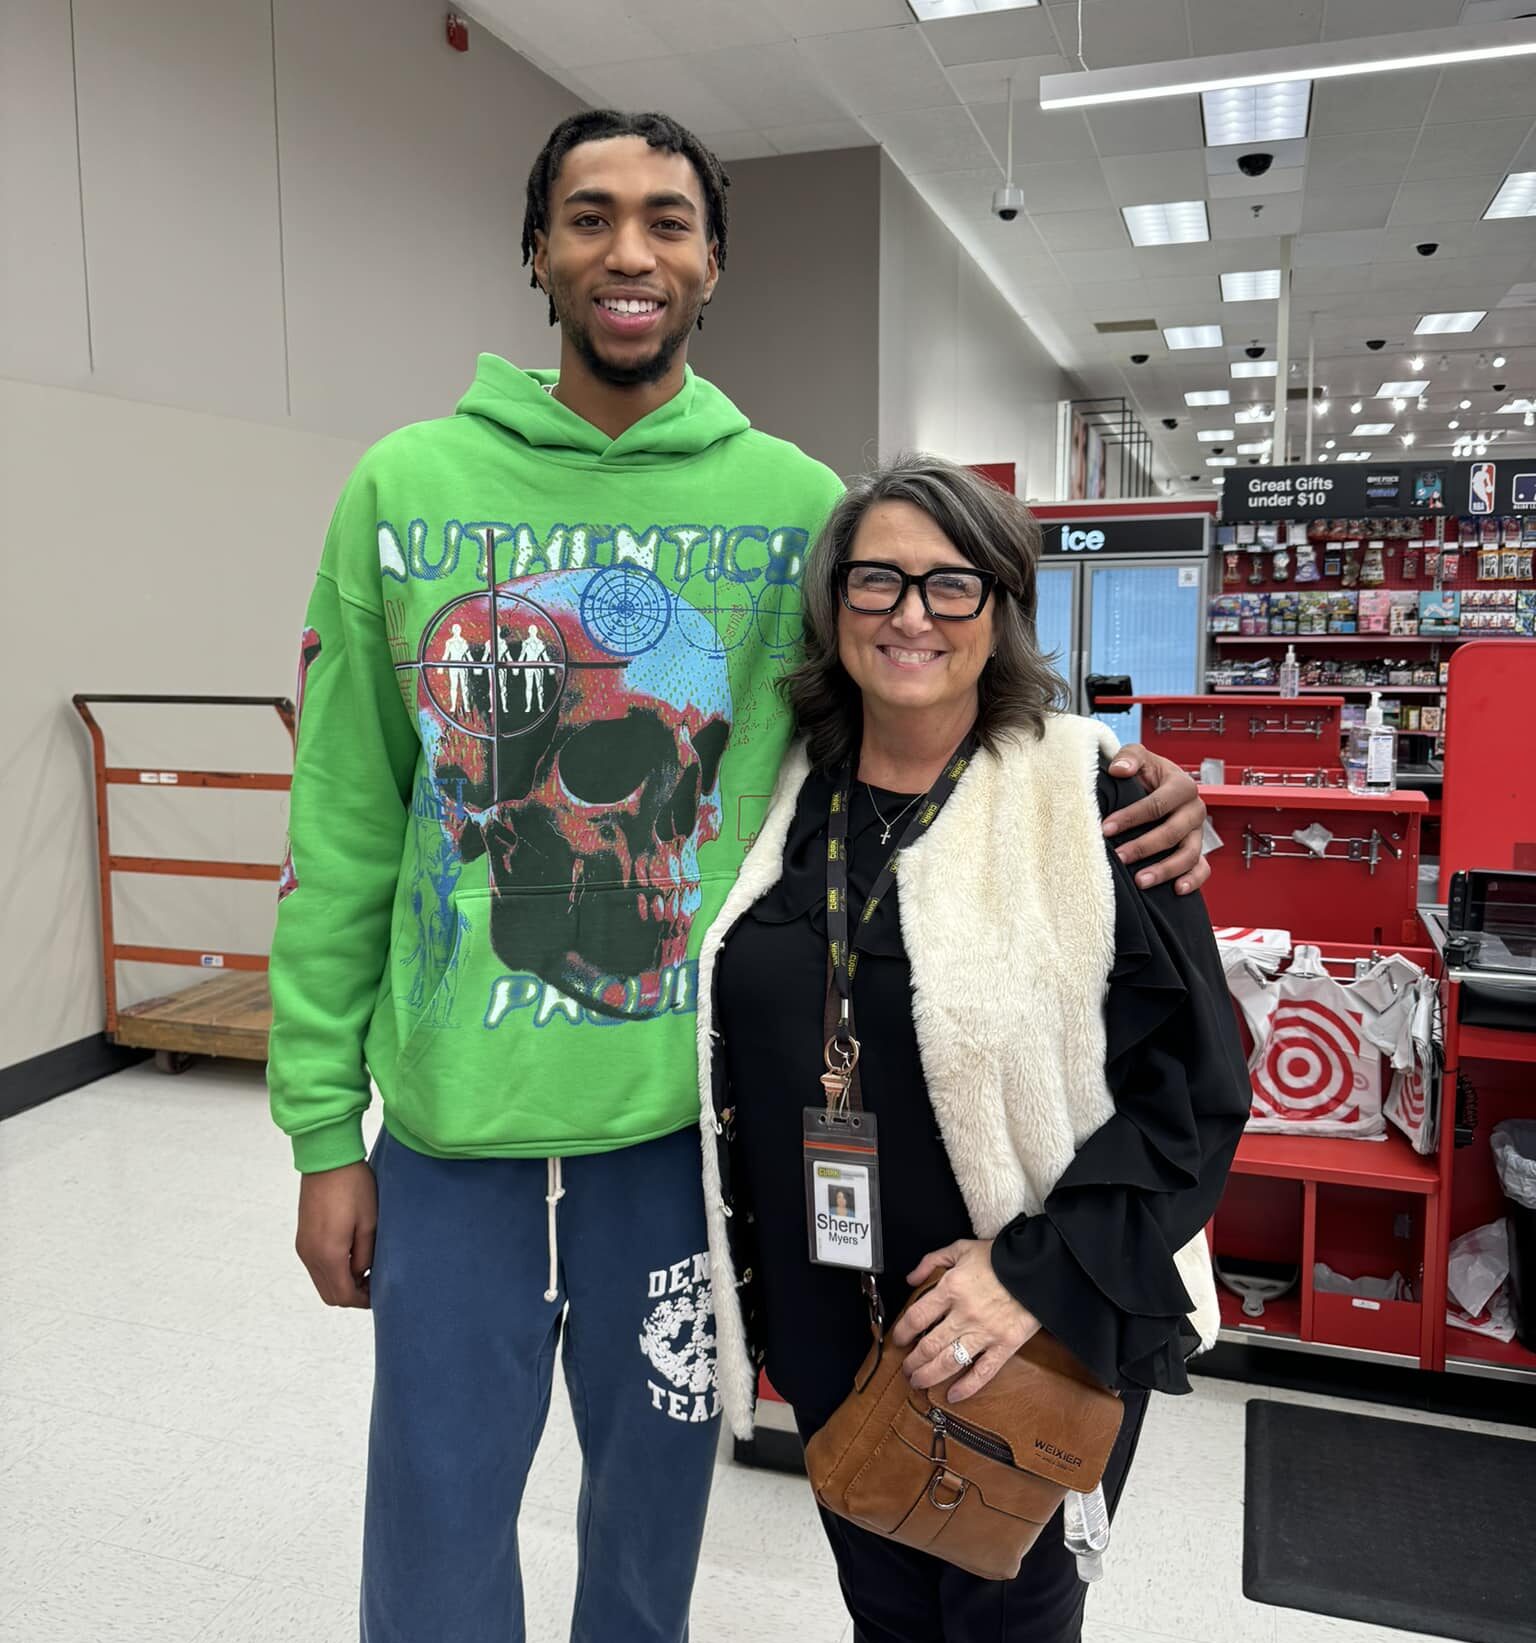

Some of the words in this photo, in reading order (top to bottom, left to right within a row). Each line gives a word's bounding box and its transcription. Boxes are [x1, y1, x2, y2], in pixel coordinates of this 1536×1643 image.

[1248, 478, 1291, 492] Great
[1295, 477, 1333, 491] Gifts
[1248, 493, 1294, 507] under
[1297, 492, 1326, 507] $10
[1061, 525, 1106, 550] ice
[817, 1213, 869, 1239] Sherry
[828, 1231, 858, 1246] Myers
[648, 1251, 710, 1298] DEN
[1034, 1439, 1082, 1467] WEIXIER
